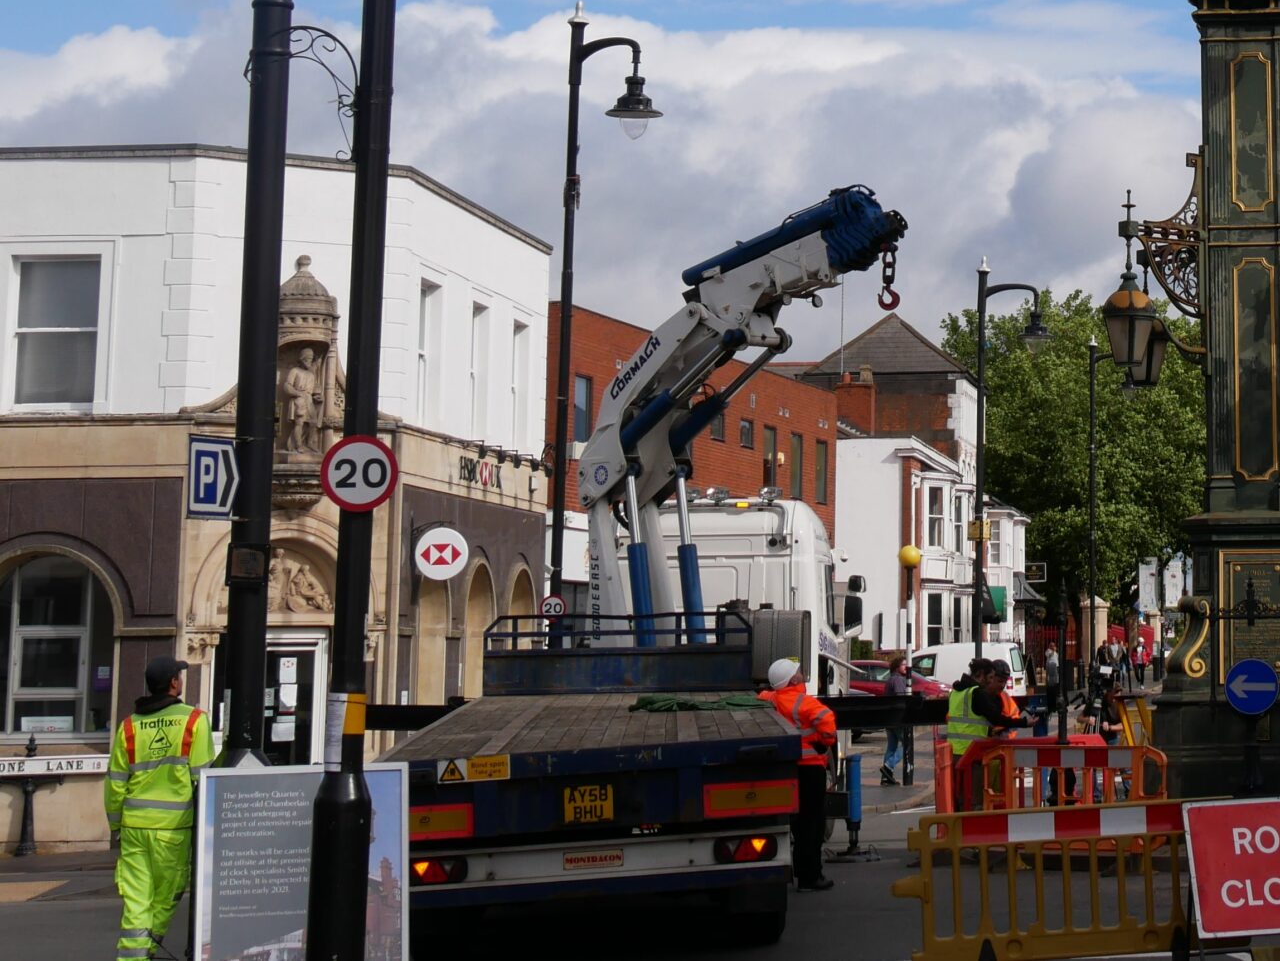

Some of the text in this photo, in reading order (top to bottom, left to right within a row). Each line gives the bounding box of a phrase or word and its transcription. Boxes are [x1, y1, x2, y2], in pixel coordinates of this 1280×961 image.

[610, 335, 662, 400] CORMACH
[200, 455, 215, 499] P
[334, 458, 388, 489] 20
[459, 456, 503, 489] HSBC UK
[544, 603, 562, 615] 20
[140, 718, 173, 730] traffix
[46, 760, 84, 771] LANE
[238, 791, 269, 800] Jewellery
[568, 788, 609, 804] AY58
[265, 799, 310, 808] Chamberlain
[251, 810, 291, 819] undergoing
[573, 805, 604, 820] BHU
[221, 820, 247, 829] project
[221, 830, 235, 838] and
[222, 849, 235, 857] The
[236, 848, 258, 856] works
[273, 847, 283, 855] be
[565, 854, 622, 864] MONTRACON
[220, 866, 308, 877] of clock specialists Smith
[219, 878, 228, 886] of
[268, 876, 302, 885] expected
[219, 888, 242, 896] return
[251, 887, 270, 896] early
